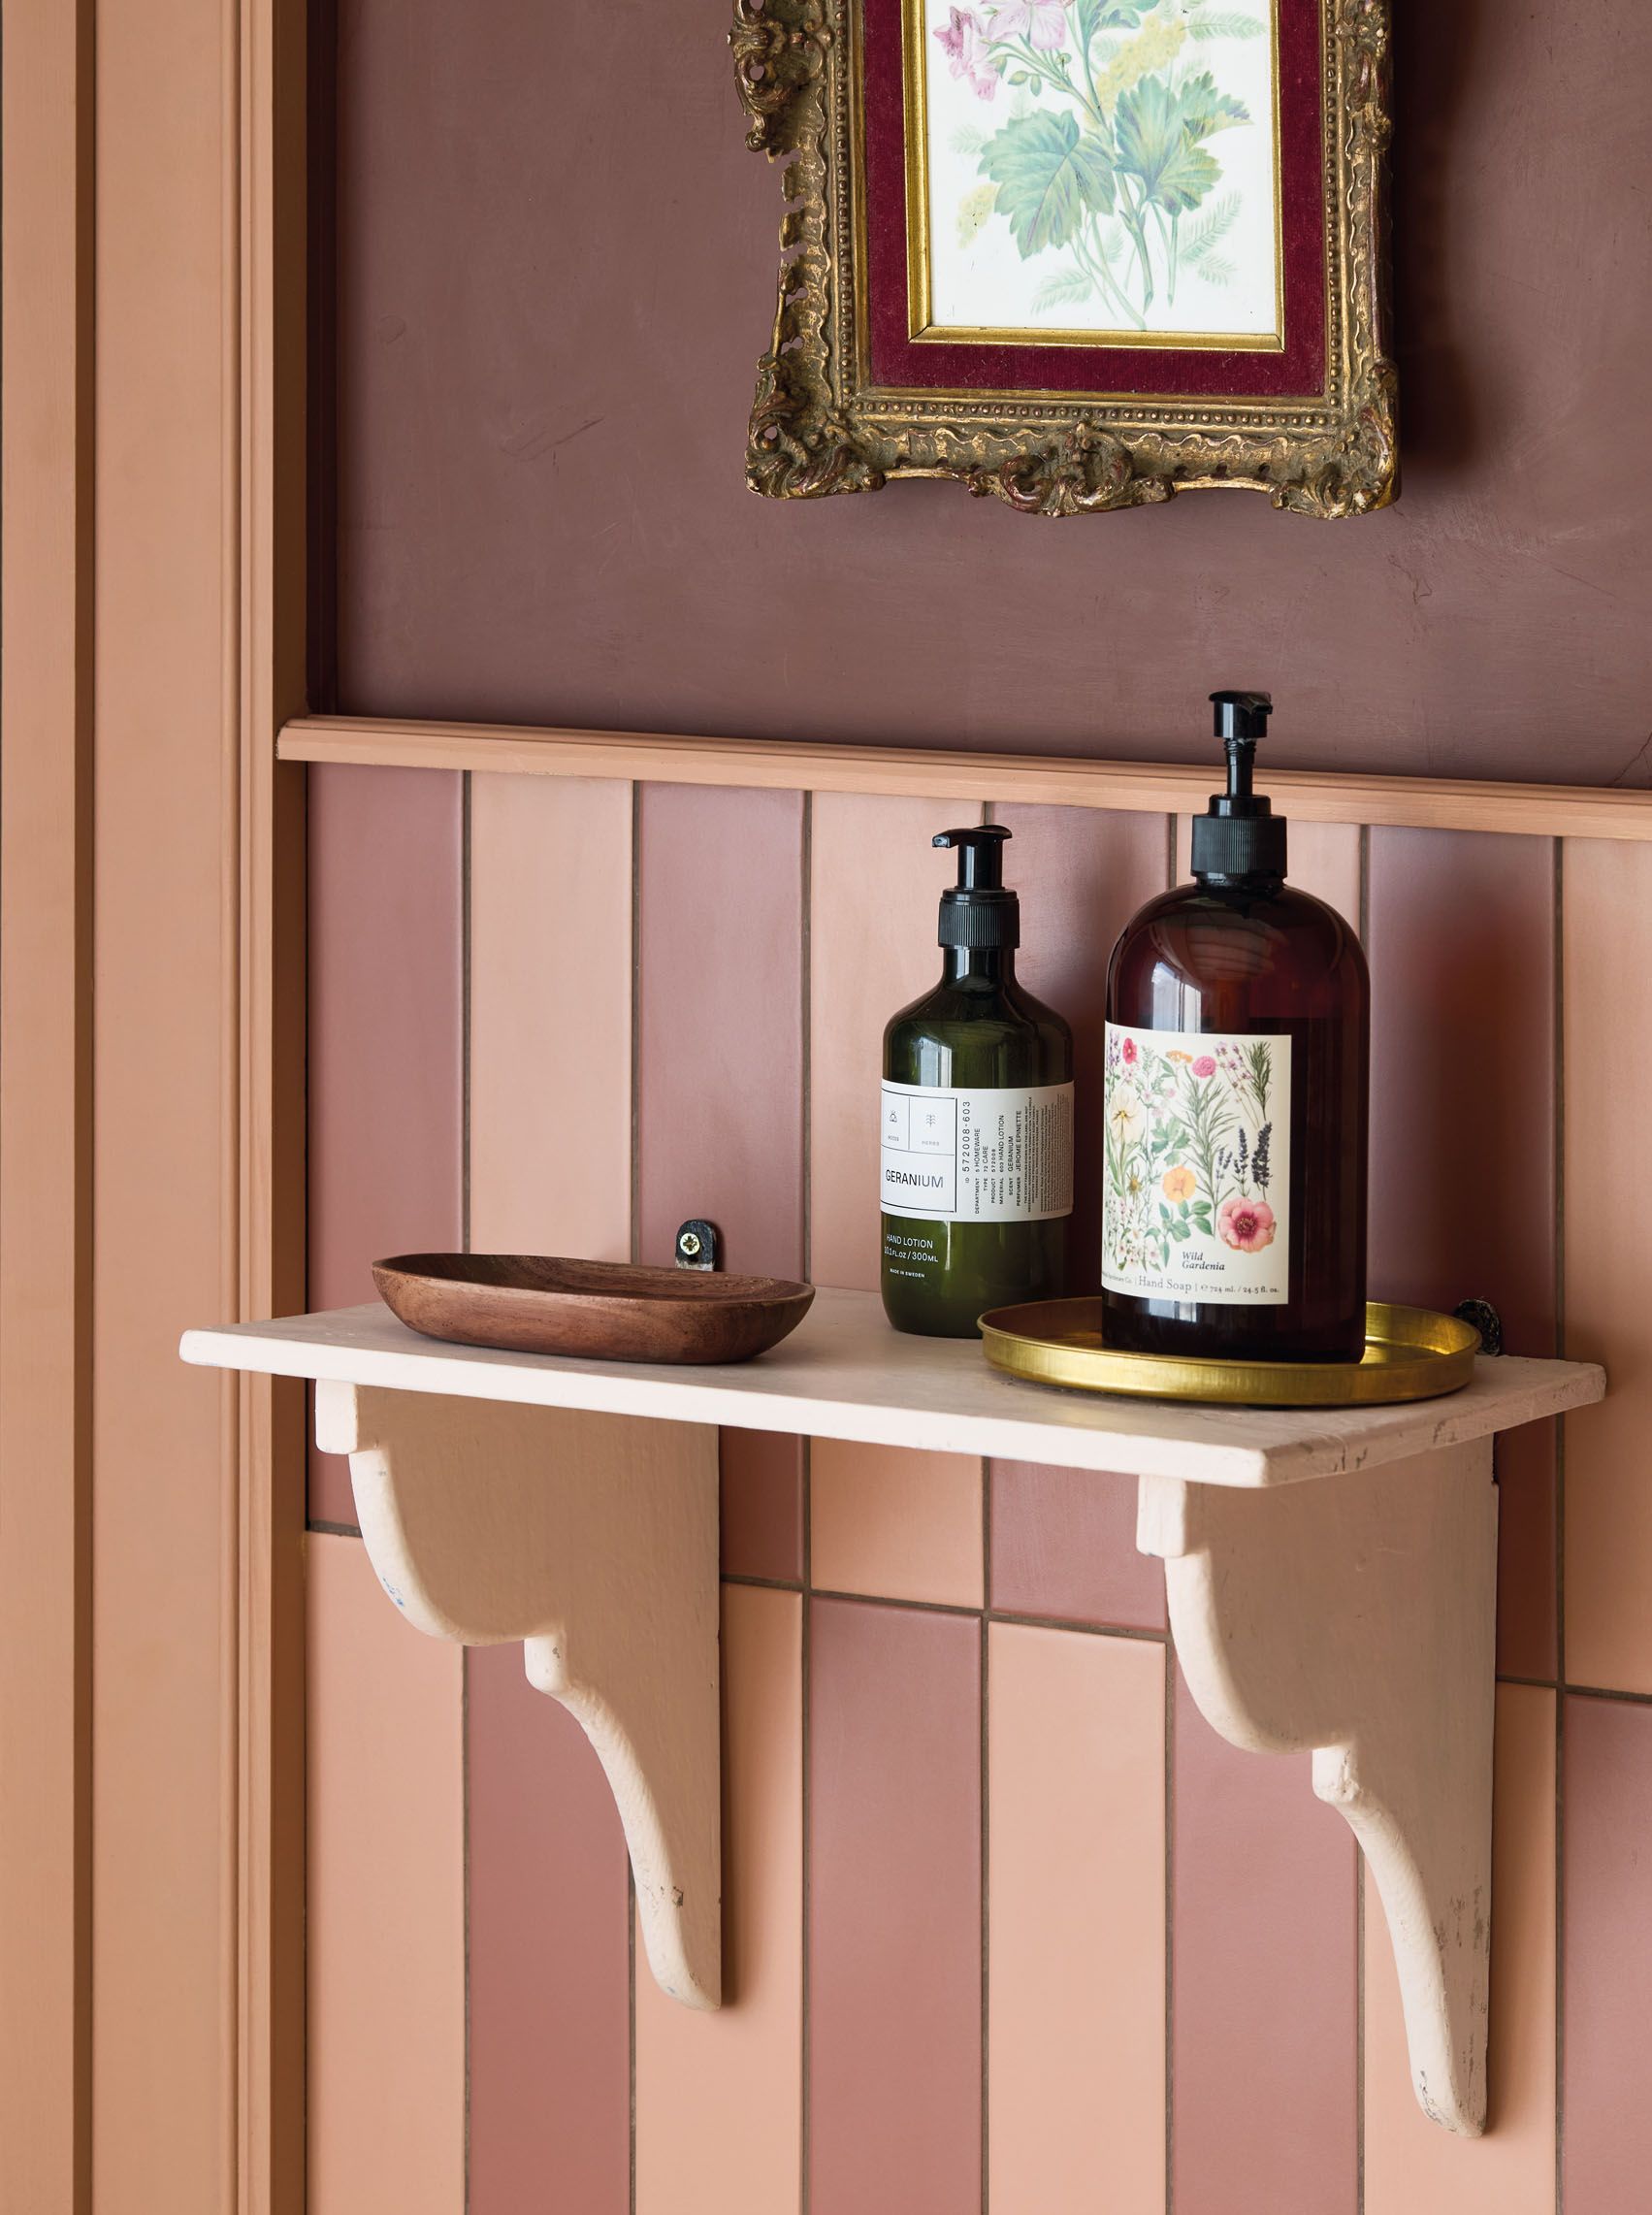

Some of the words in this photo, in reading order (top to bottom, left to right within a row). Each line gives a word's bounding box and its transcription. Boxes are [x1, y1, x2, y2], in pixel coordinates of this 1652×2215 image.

[885, 1169, 944, 1188] GERANIUM
[886, 1234, 901, 1244] HAND
[903, 1237, 933, 1249] LOTION
[912, 1252, 939, 1263] 300ML
[1182, 1251, 1203, 1261] Wild
[1182, 1260, 1225, 1270] Gardenia
[1139, 1275, 1163, 1288] Hand
[1166, 1279, 1192, 1293] Soap
